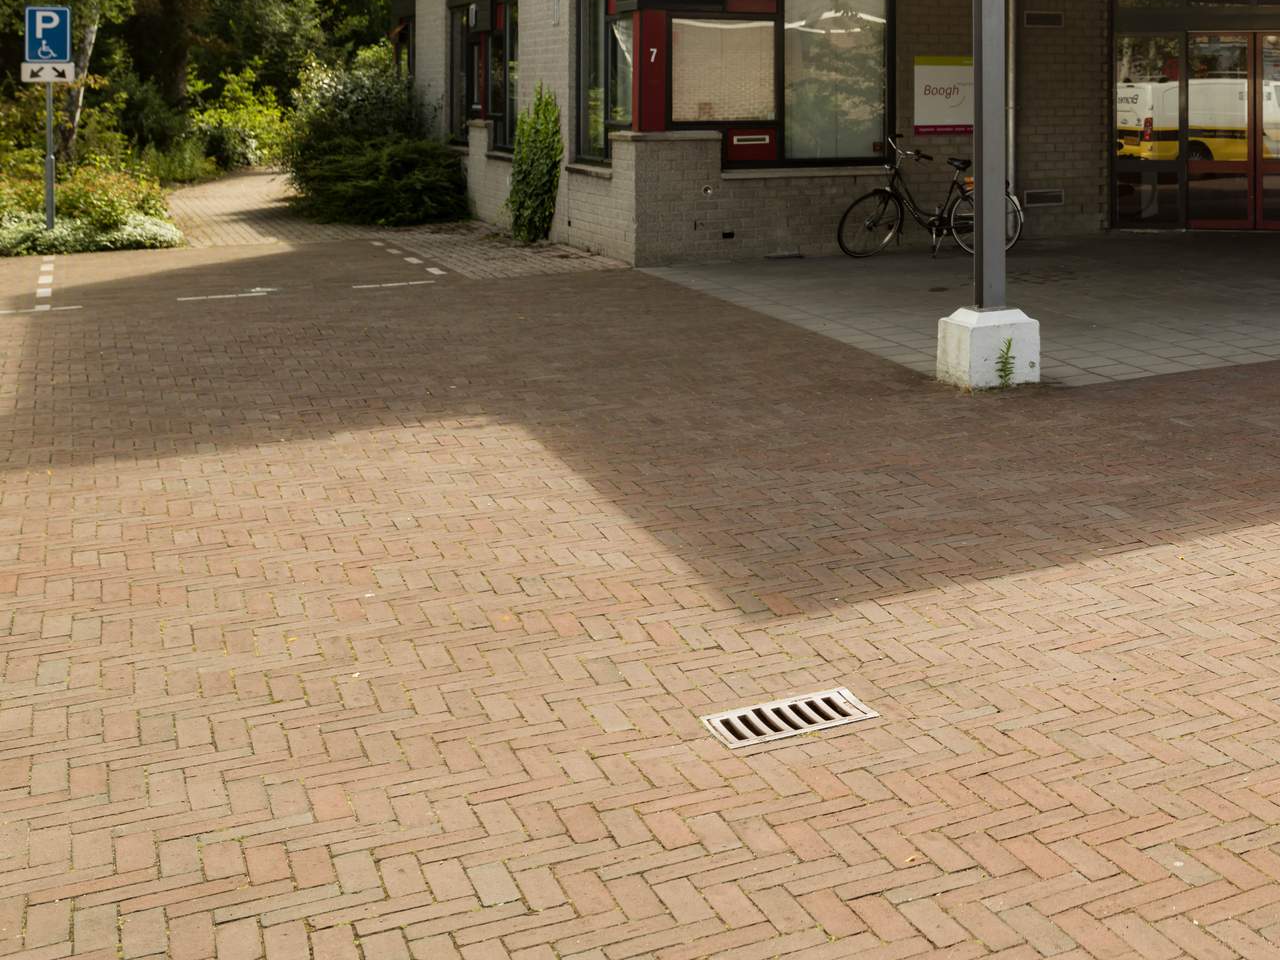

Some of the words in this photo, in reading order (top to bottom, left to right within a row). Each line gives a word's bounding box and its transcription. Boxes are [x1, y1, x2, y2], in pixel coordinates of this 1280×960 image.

[35, 10, 60, 39] P
[649, 47, 658, 63] 7
[923, 84, 960, 100] Boogh
